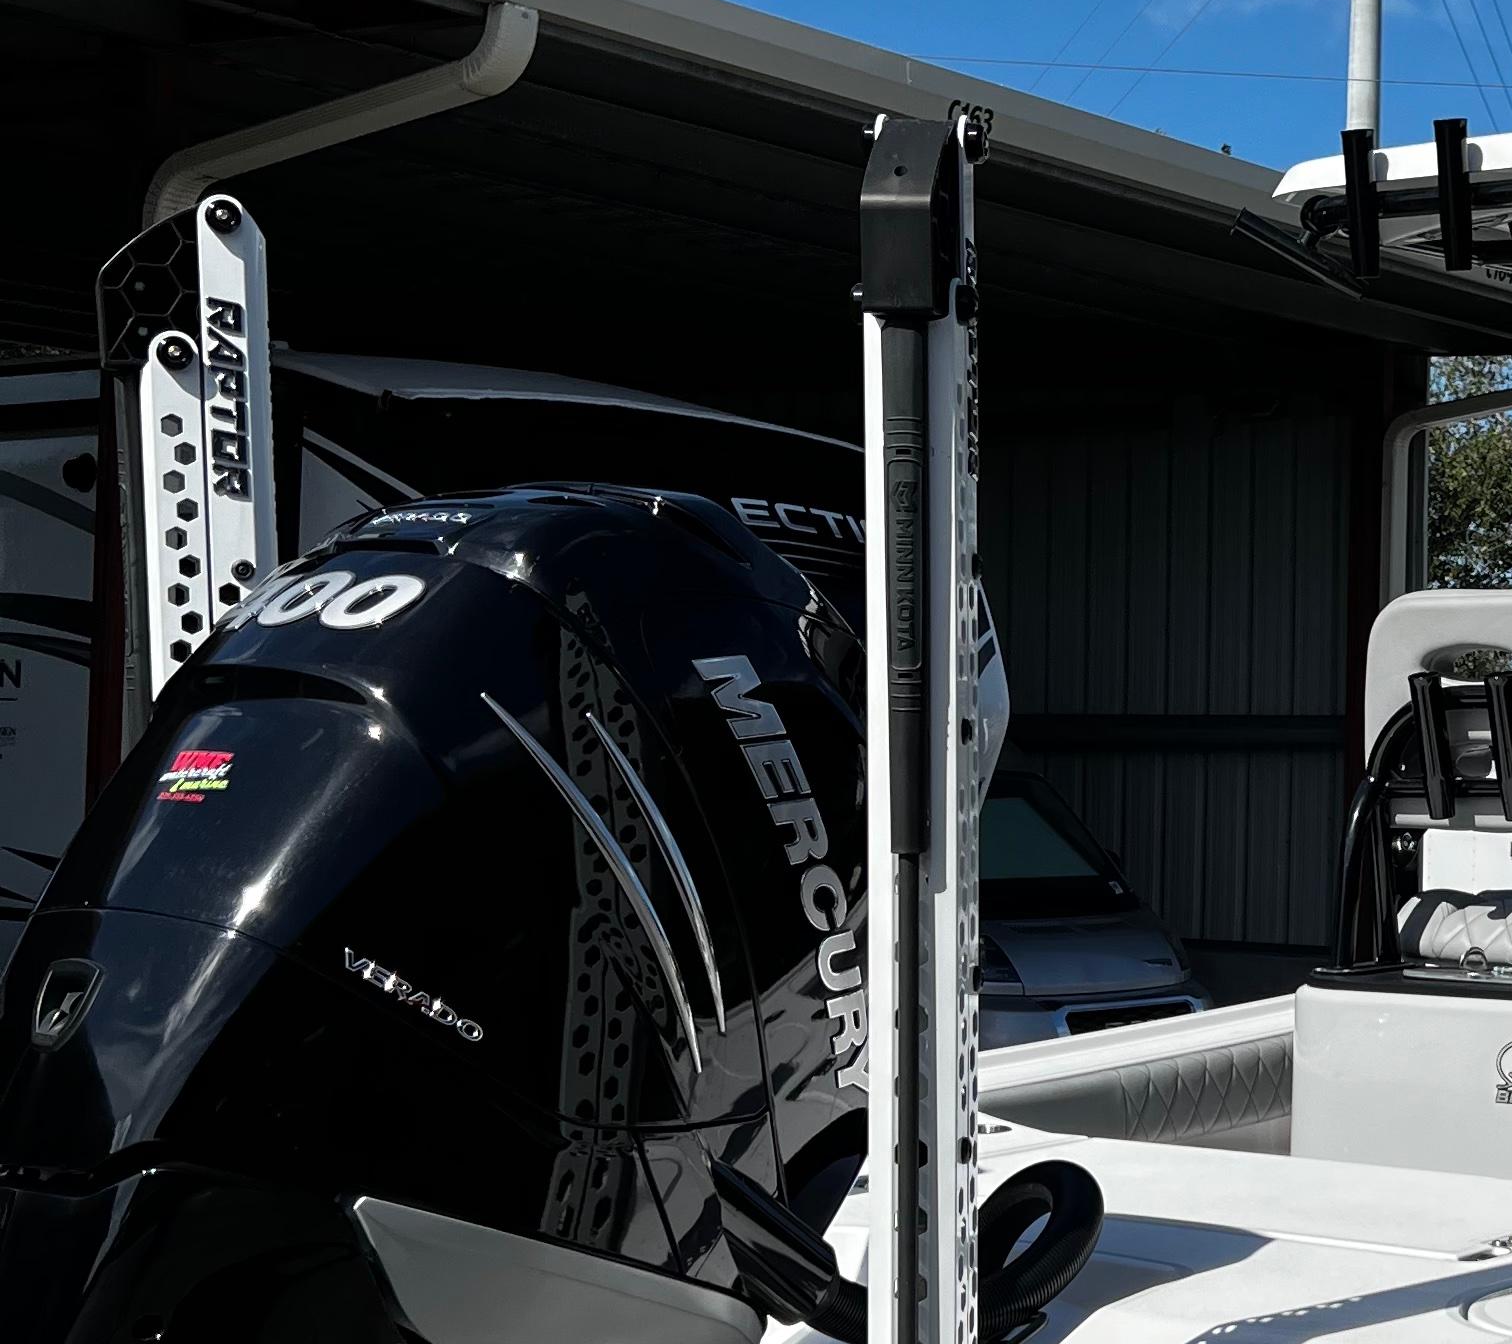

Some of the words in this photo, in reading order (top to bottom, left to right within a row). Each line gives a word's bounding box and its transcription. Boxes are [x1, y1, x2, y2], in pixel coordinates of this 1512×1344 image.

[206, 296, 252, 503] RAPTOR
[730, 496, 866, 544] ECTI
[895, 518, 916, 584] MINN
[895, 587, 917, 654] KOTA
[691, 654, 869, 1090] MERCURY
[344, 946, 484, 1042] VERADO
